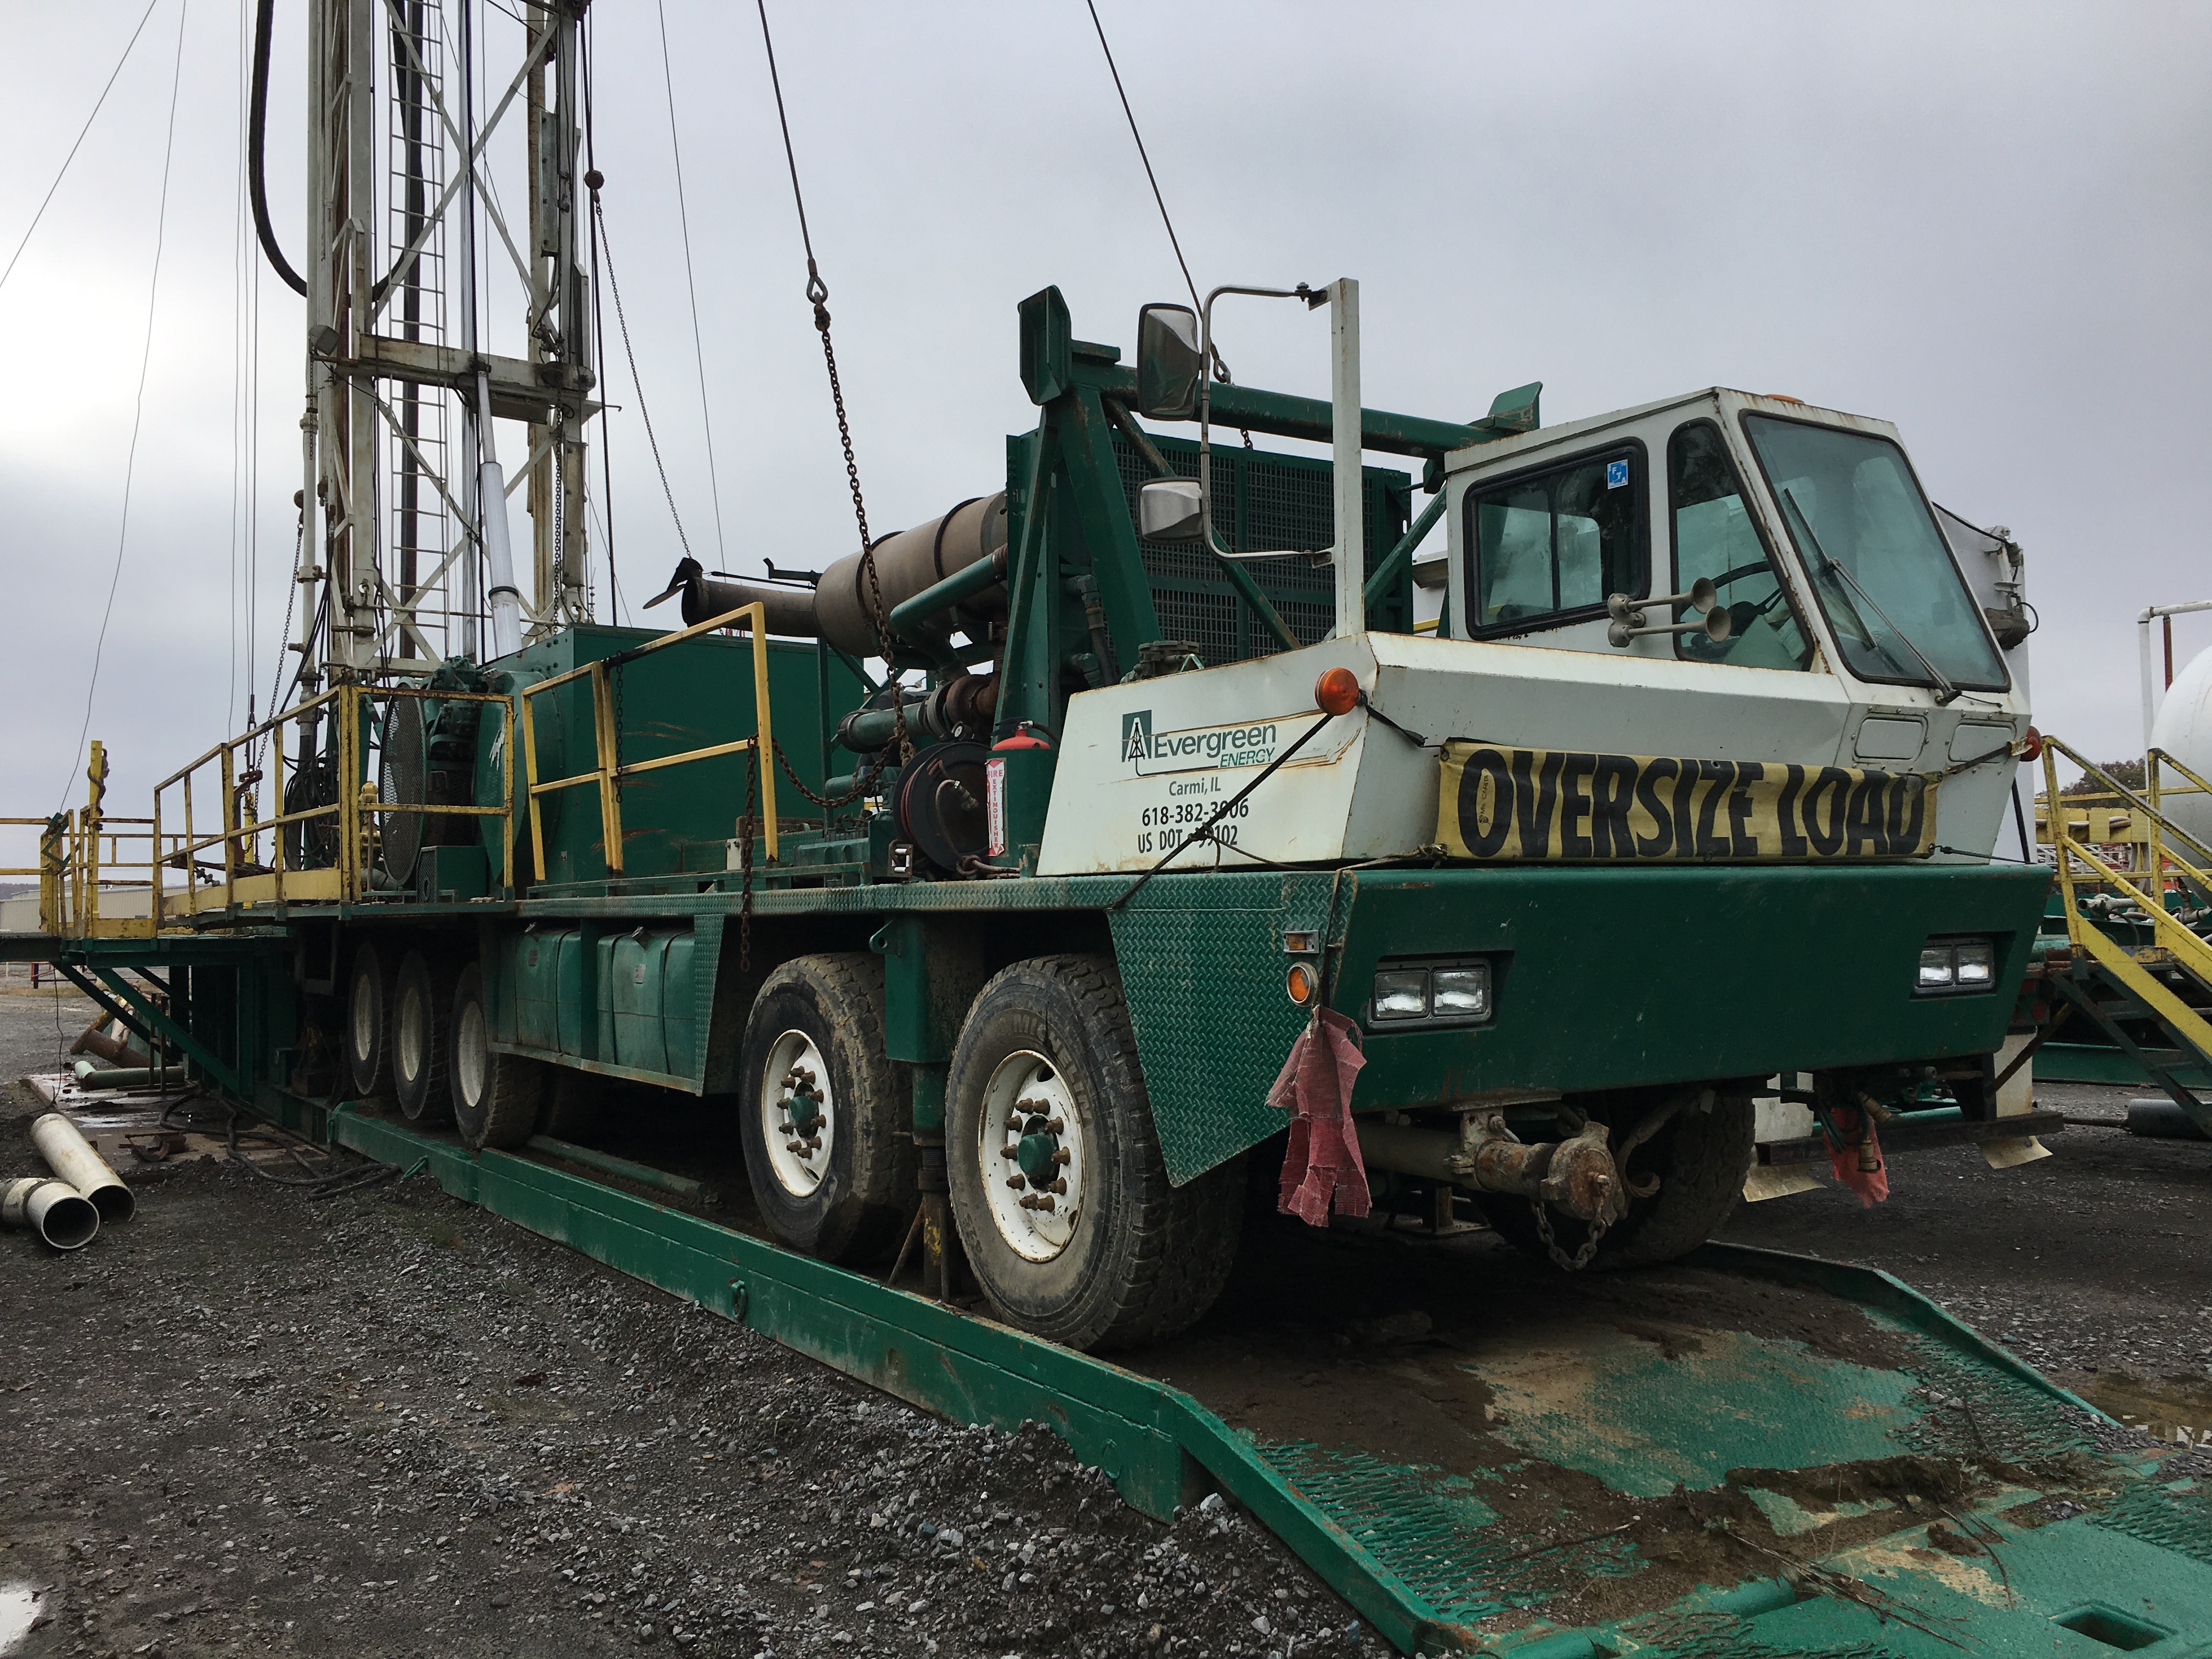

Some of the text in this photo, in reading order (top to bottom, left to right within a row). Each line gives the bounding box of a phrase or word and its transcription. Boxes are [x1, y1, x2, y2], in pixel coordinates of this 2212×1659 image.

[1154, 724, 1276, 758] Evergreen
[1220, 747, 1275, 768] ENERGY
[989, 769, 1003, 778] FIRE
[1169, 777, 1221, 795] Carmi, IL
[1458, 748, 1927, 857] OVERSIZE LOAD
[1138, 832, 1152, 854] US
[1160, 828, 1183, 850] DOT
